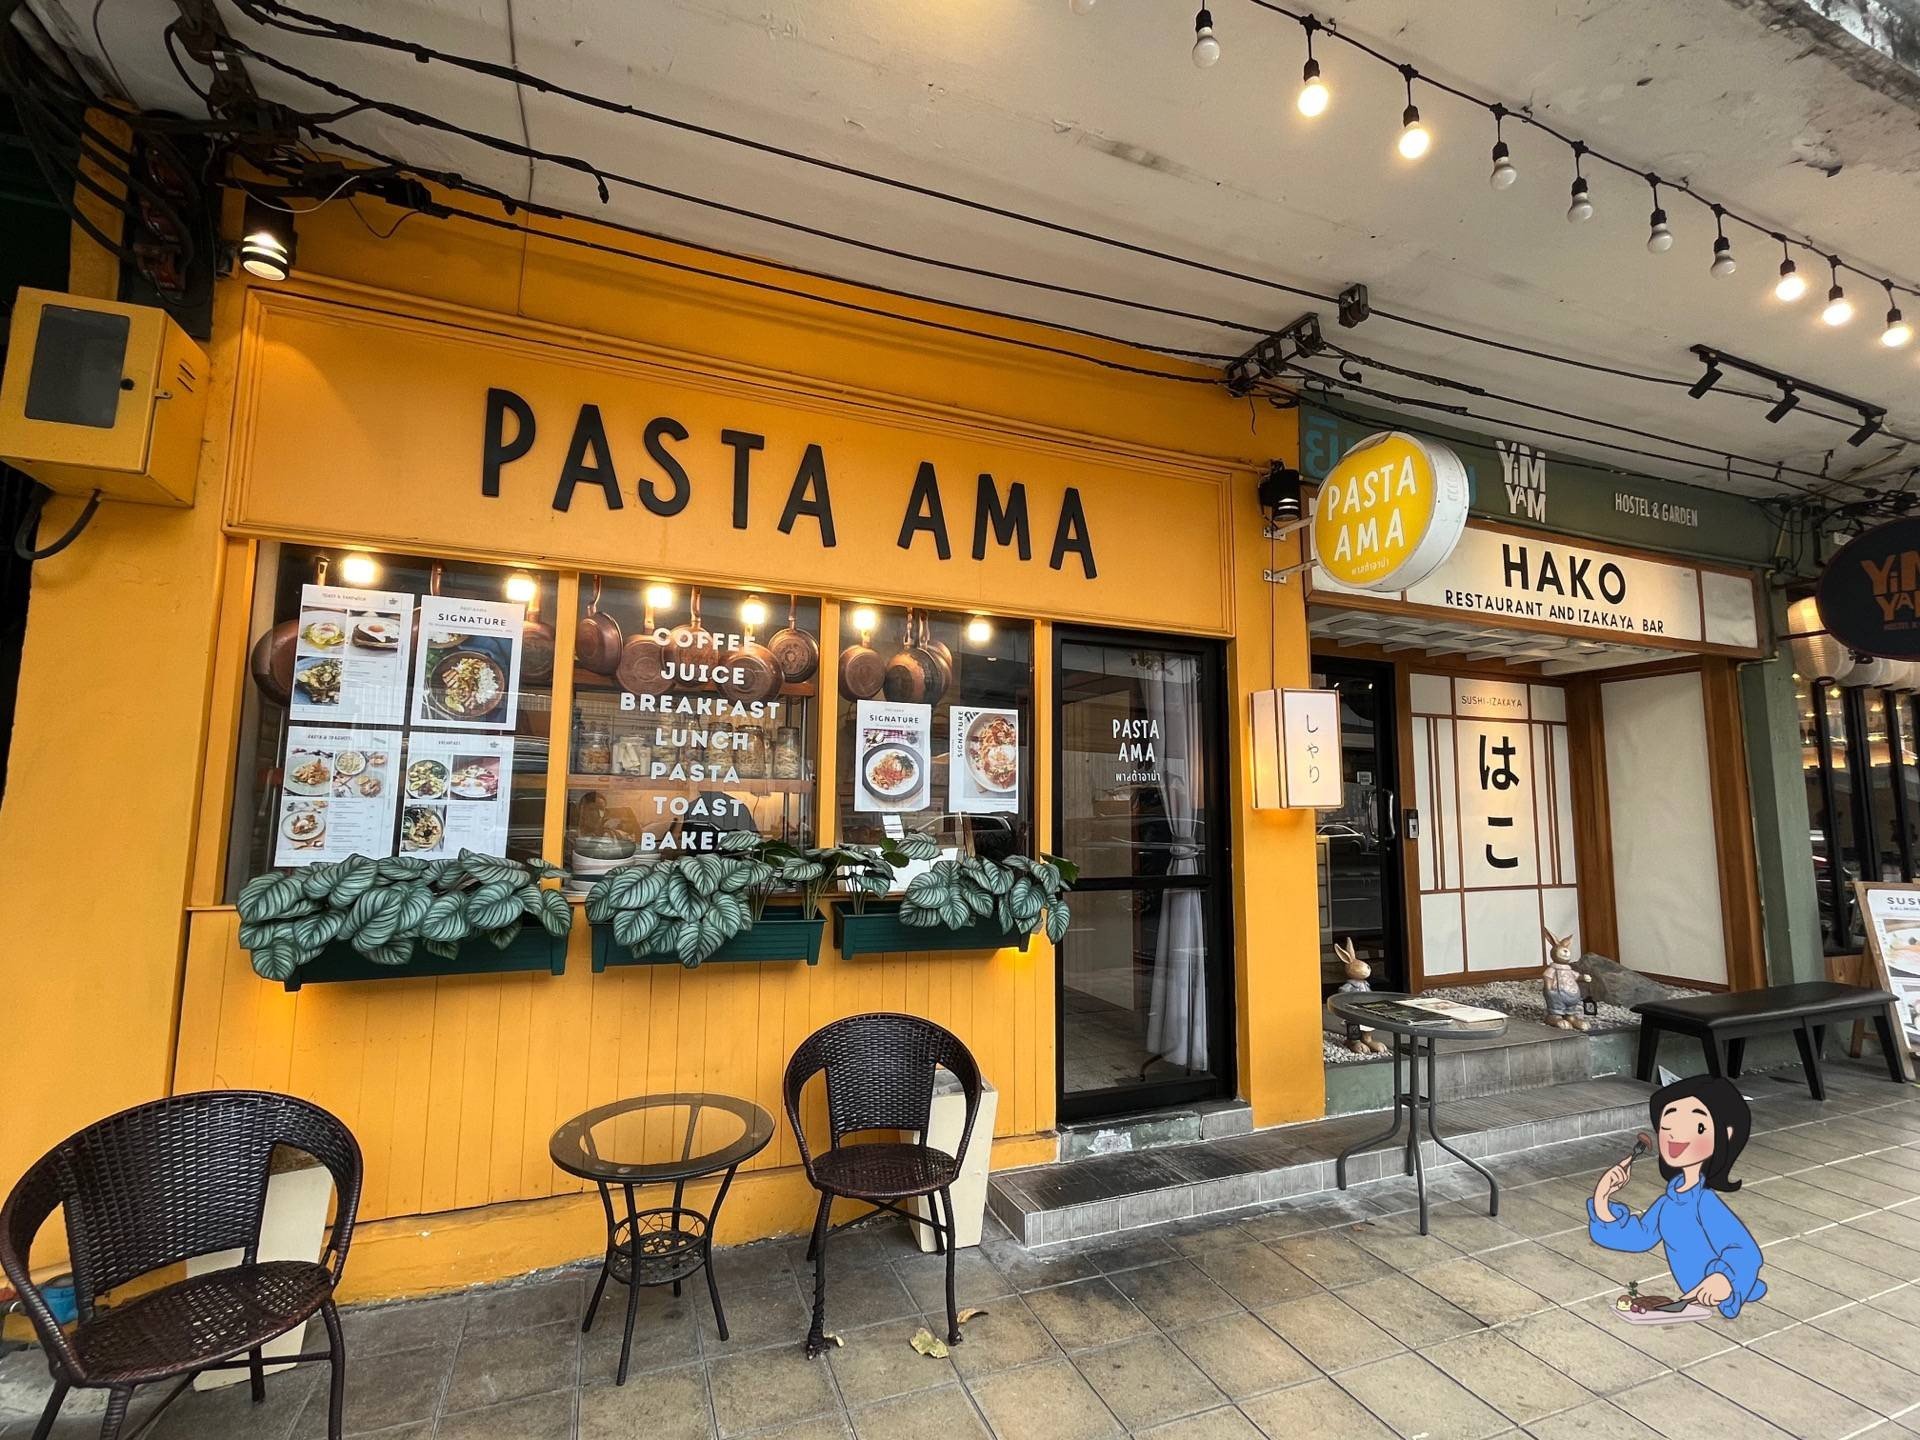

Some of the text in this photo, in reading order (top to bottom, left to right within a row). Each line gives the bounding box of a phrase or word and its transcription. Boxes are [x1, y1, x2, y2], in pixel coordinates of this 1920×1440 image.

[482, 387, 1098, 579] PASTA AMA
[1327, 455, 1417, 522] PASTA
[1505, 484, 1547, 523] YAM
[1615, 492, 1699, 528] HOSTEL & GARDEN
[1334, 508, 1405, 562] AMA
[1502, 543, 1626, 605] HAKO
[438, 613, 507, 627] SIGNATURE
[1445, 589, 1664, 634] RESTAURANT AND IZAKAYA BAR
[653, 627, 755, 652] COFFEE
[661, 661, 745, 685] JUICE
[620, 692, 780, 720] BREAKFAST
[1461, 695, 1523, 707] SUSHI-IZAKAYA
[869, 714, 919, 724] SIGNATURE
[1112, 718, 1160, 740] PASTA
[655, 727, 749, 751] LUNCH
[1118, 742, 1156, 763] AMA
[650, 762, 740, 784] PASTA
[653, 796, 745, 817] TOAST
[1479, 734, 1520, 869] はこ
[640, 830, 752, 852] BAKE
